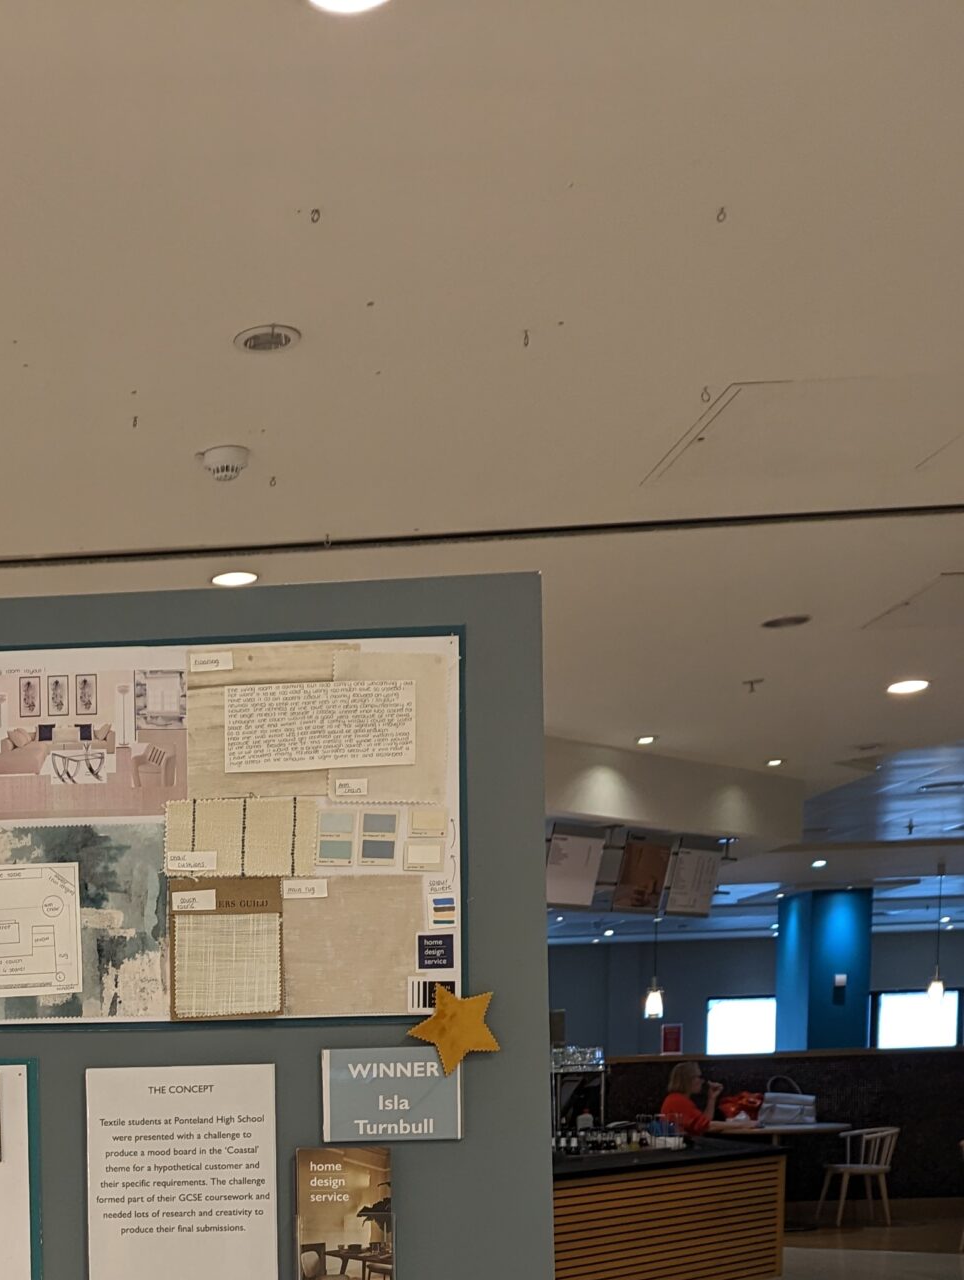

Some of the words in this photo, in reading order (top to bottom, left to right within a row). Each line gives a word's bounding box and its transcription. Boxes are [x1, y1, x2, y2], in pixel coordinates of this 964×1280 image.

[239, 900, 269, 908] GUILD
[424, 938, 443, 946] home
[424, 948, 445, 957] design
[348, 1061, 440, 1079] WINNER
[148, 1085, 167, 1095] THE
[168, 1084, 214, 1094] CONCEPT
[378, 1094, 410, 1111] Isla
[100, 1118, 126, 1126] Textile
[127, 1117, 162, 1126] students
[163, 1116, 172, 1125] at
[174, 1116, 214, 1125] Ponteland
[216, 1115, 235, 1126] High
[237, 1114, 264, 1123] School
[354, 1118, 434, 1136] Turnbull
[134, 1132, 174, 1143] presented
[176, 1131, 194, 1140] with
[203, 1130, 240, 1141] challenge
[242, 1130, 252, 1138] to
[105, 1148, 138, 1159] produce
[147, 1147, 171, 1156] mood
[173, 1146, 197, 1155] board
[198, 1146, 207, 1155] in
[208, 1146, 222, 1154] the
[105, 1163, 130, 1172] theme
[132, 1163, 145, 1172] for
[153, 1162, 202, 1173] hypothetical
[204, 1161, 243, 1170] customer
[244, 1161, 260, 1170] and
[310, 1160, 342, 1173] home
[100, 1180, 120, 1189] their
[121, 1179, 150, 1190] specific
[152, 1178, 208, 1189] requirements.
[211, 1177, 226, 1186] The
[228, 1177, 266, 1187] challenge
[310, 1176, 346, 1190] design
[96, 1195, 125, 1203] formed
[127, 1194, 144, 1205] part
[146, 1194, 155, 1203] of
[156, 1193, 176, 1202] their
[178, 1193, 202, 1202] GCSE
[204, 1192, 254, 1201] coursework
[255, 1191, 270, 1200] and
[310, 1191, 349, 1202] service
[102, 1210, 132, 1218] needed
[134, 1209, 149, 1218] lots
[151, 1209, 160, 1218] of
[161, 1208, 196, 1217] research
[198, 1208, 213, 1217] and
[215, 1207, 252, 1218] creativity
[254, 1207, 264, 1215] to
[120, 1225, 154, 1236] produce
[156, 1224, 175, 1233] their
[177, 1224, 194, 1233] final
[196, 1223, 246, 1232] submissions.
